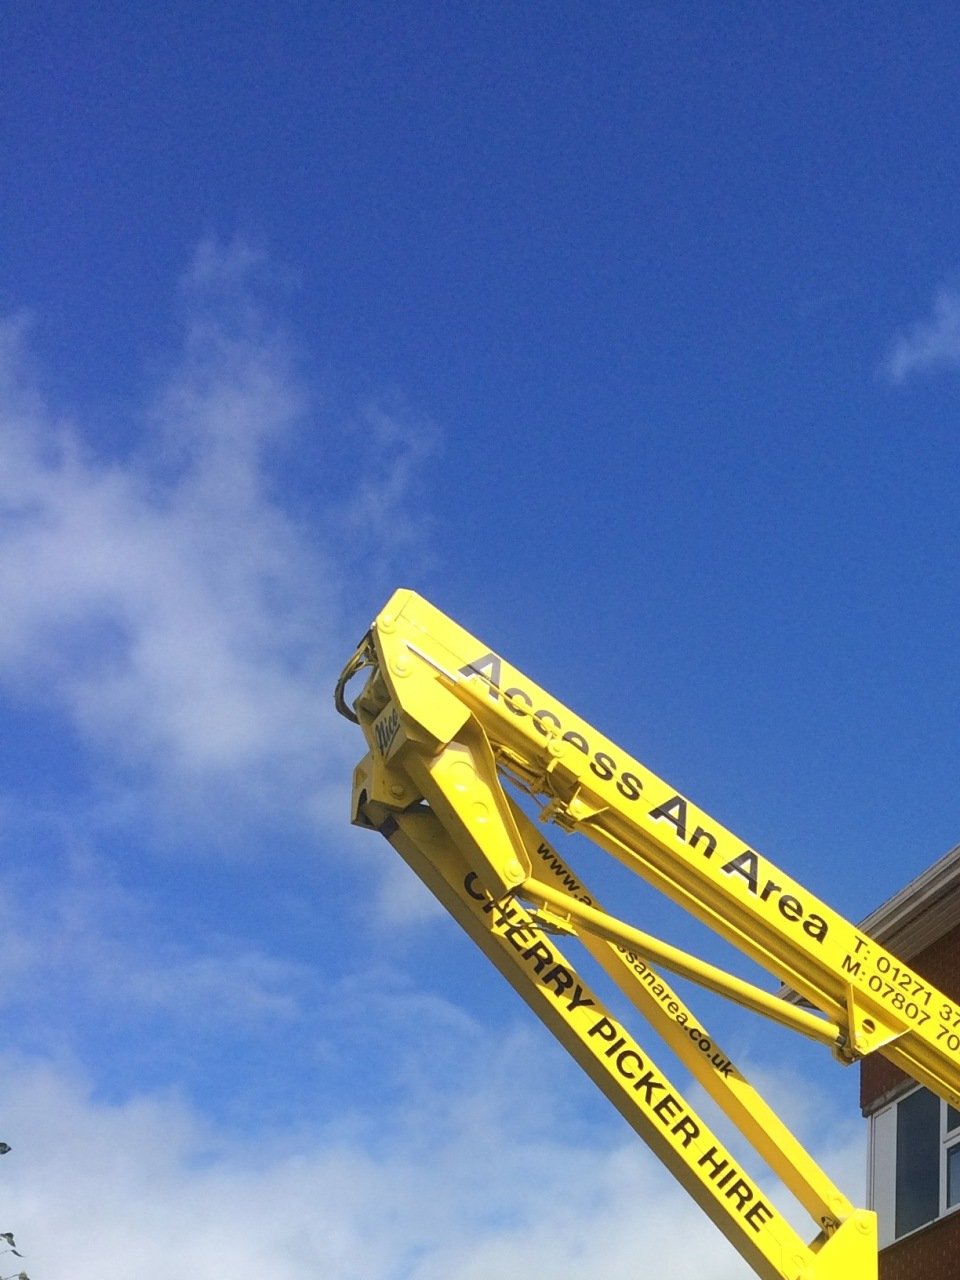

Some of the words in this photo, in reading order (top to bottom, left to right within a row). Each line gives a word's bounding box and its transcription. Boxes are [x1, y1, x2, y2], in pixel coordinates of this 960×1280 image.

[458, 652, 643, 801] Access
[649, 795, 717, 859] An
[721, 849, 829, 944] Area
[464, 871, 595, 1012] CHERRY
[587, 1017, 700, 1149] PICKER
[697, 1146, 774, 1233] HIRE
[536, 842, 735, 1079] www.asanarea.co.uk
[841, 955, 866, 981] M:
[869, 978, 931, 1027] 07807
[854, 936, 871, 960] T:
[877, 956, 933, 1006] 01271
